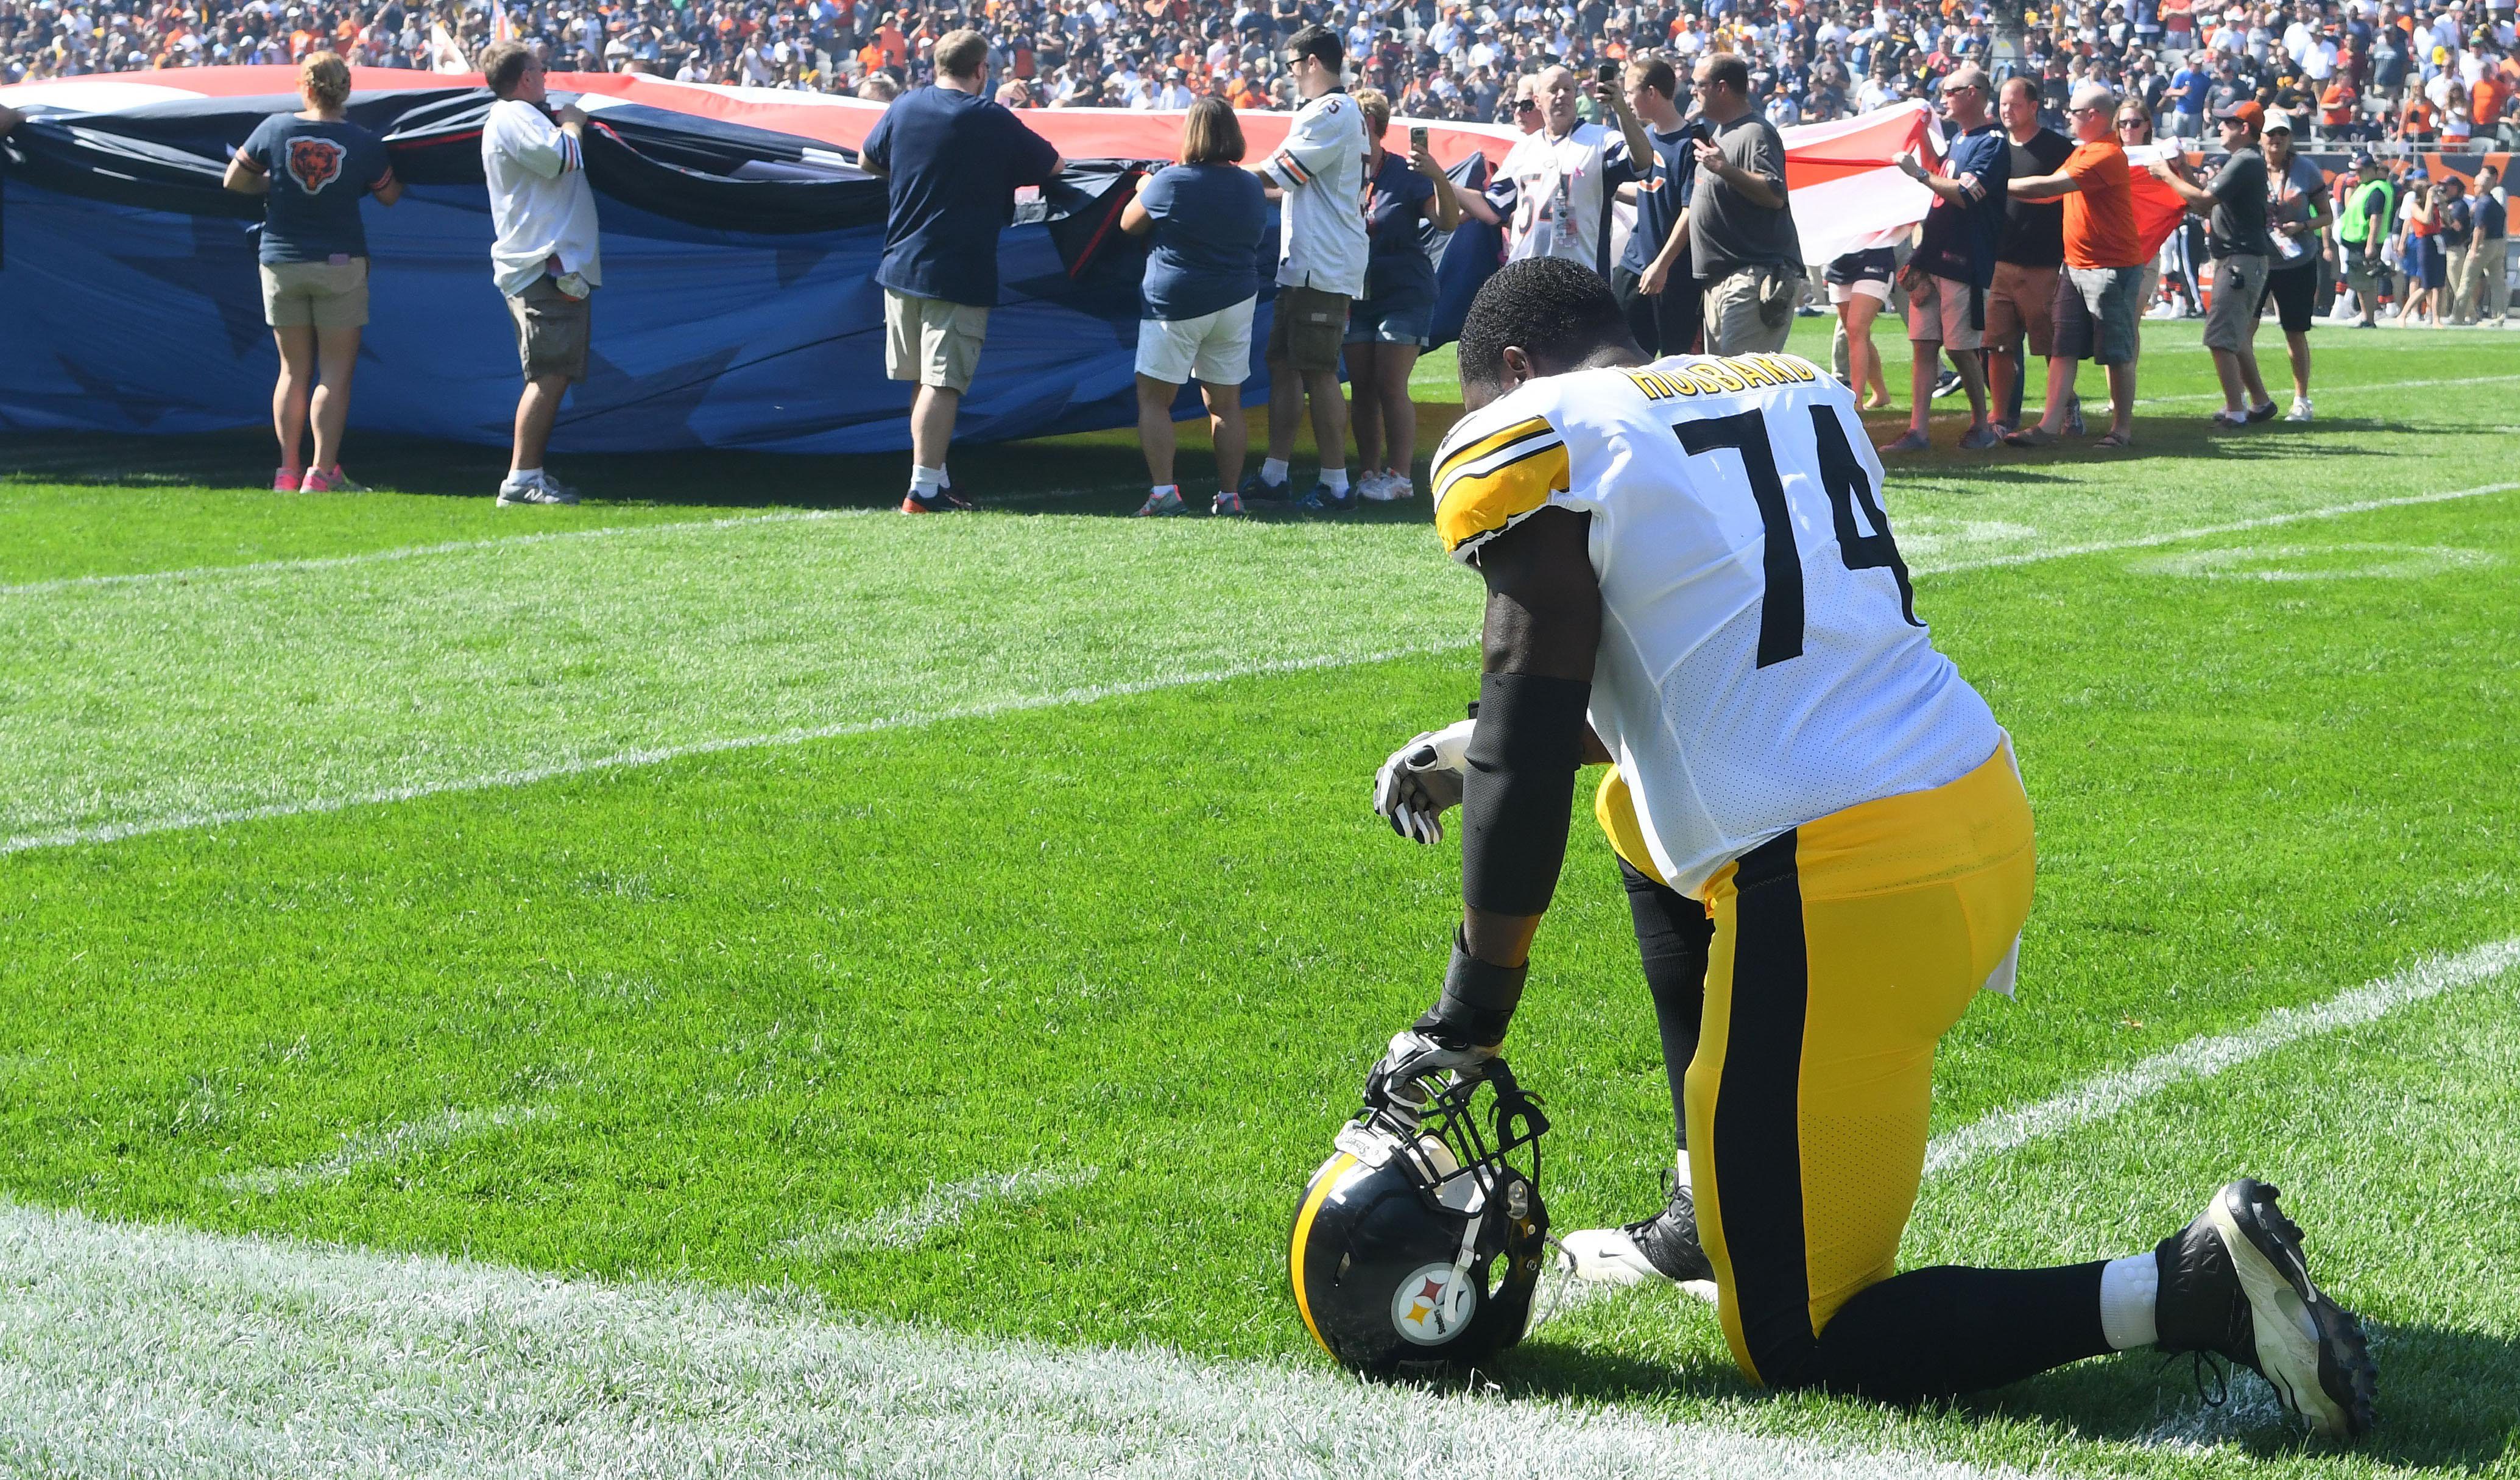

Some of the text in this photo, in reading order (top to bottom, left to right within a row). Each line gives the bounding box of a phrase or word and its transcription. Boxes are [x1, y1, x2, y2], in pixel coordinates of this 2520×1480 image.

[1626, 354, 1816, 401] HUBBARD
[1671, 404, 1928, 669] 74
[1433, 1309, 1446, 1334] Steelers
